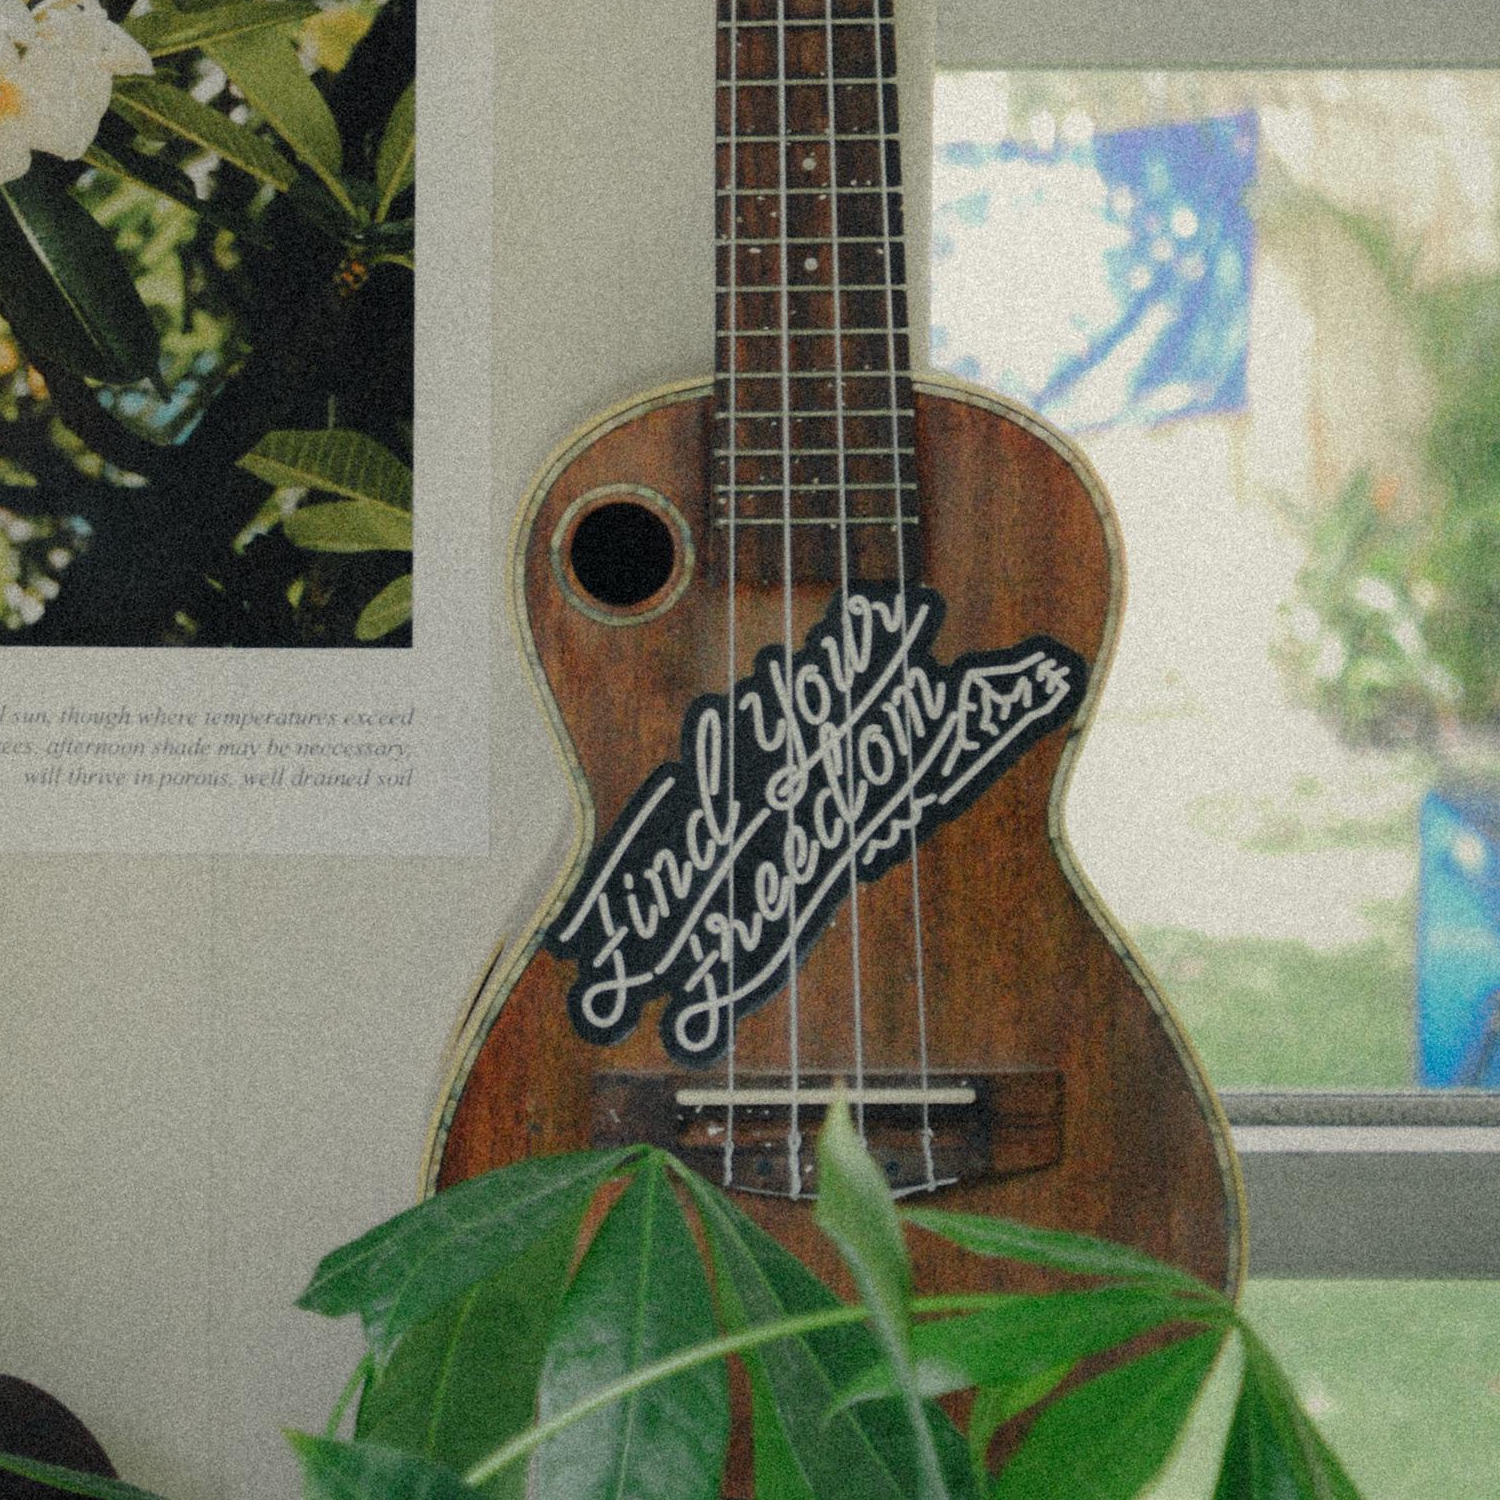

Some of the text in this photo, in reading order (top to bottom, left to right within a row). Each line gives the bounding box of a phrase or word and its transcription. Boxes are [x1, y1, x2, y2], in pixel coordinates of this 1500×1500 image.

[13, 710, 51, 727] sun,
[59, 705, 131, 730] though
[138, 706, 197, 726] where
[204, 709, 337, 731] temperatures
[342, 705, 416, 727] exceed
[45, 736, 145, 759] afternoon
[152, 736, 211, 757] shade
[217, 742, 259, 761] may
[267, 738, 290, 757] be
[23, 766, 62, 786] will
[67, 766, 125, 787] thrive
[134, 770, 154, 788] in
[243, 767, 285, 788] well
[290, 767, 372, 788] drained
[377, 767, 414, 788] soil
[560, 708, 739, 1029] Find
[655, 666, 946, 1051] Freedom
